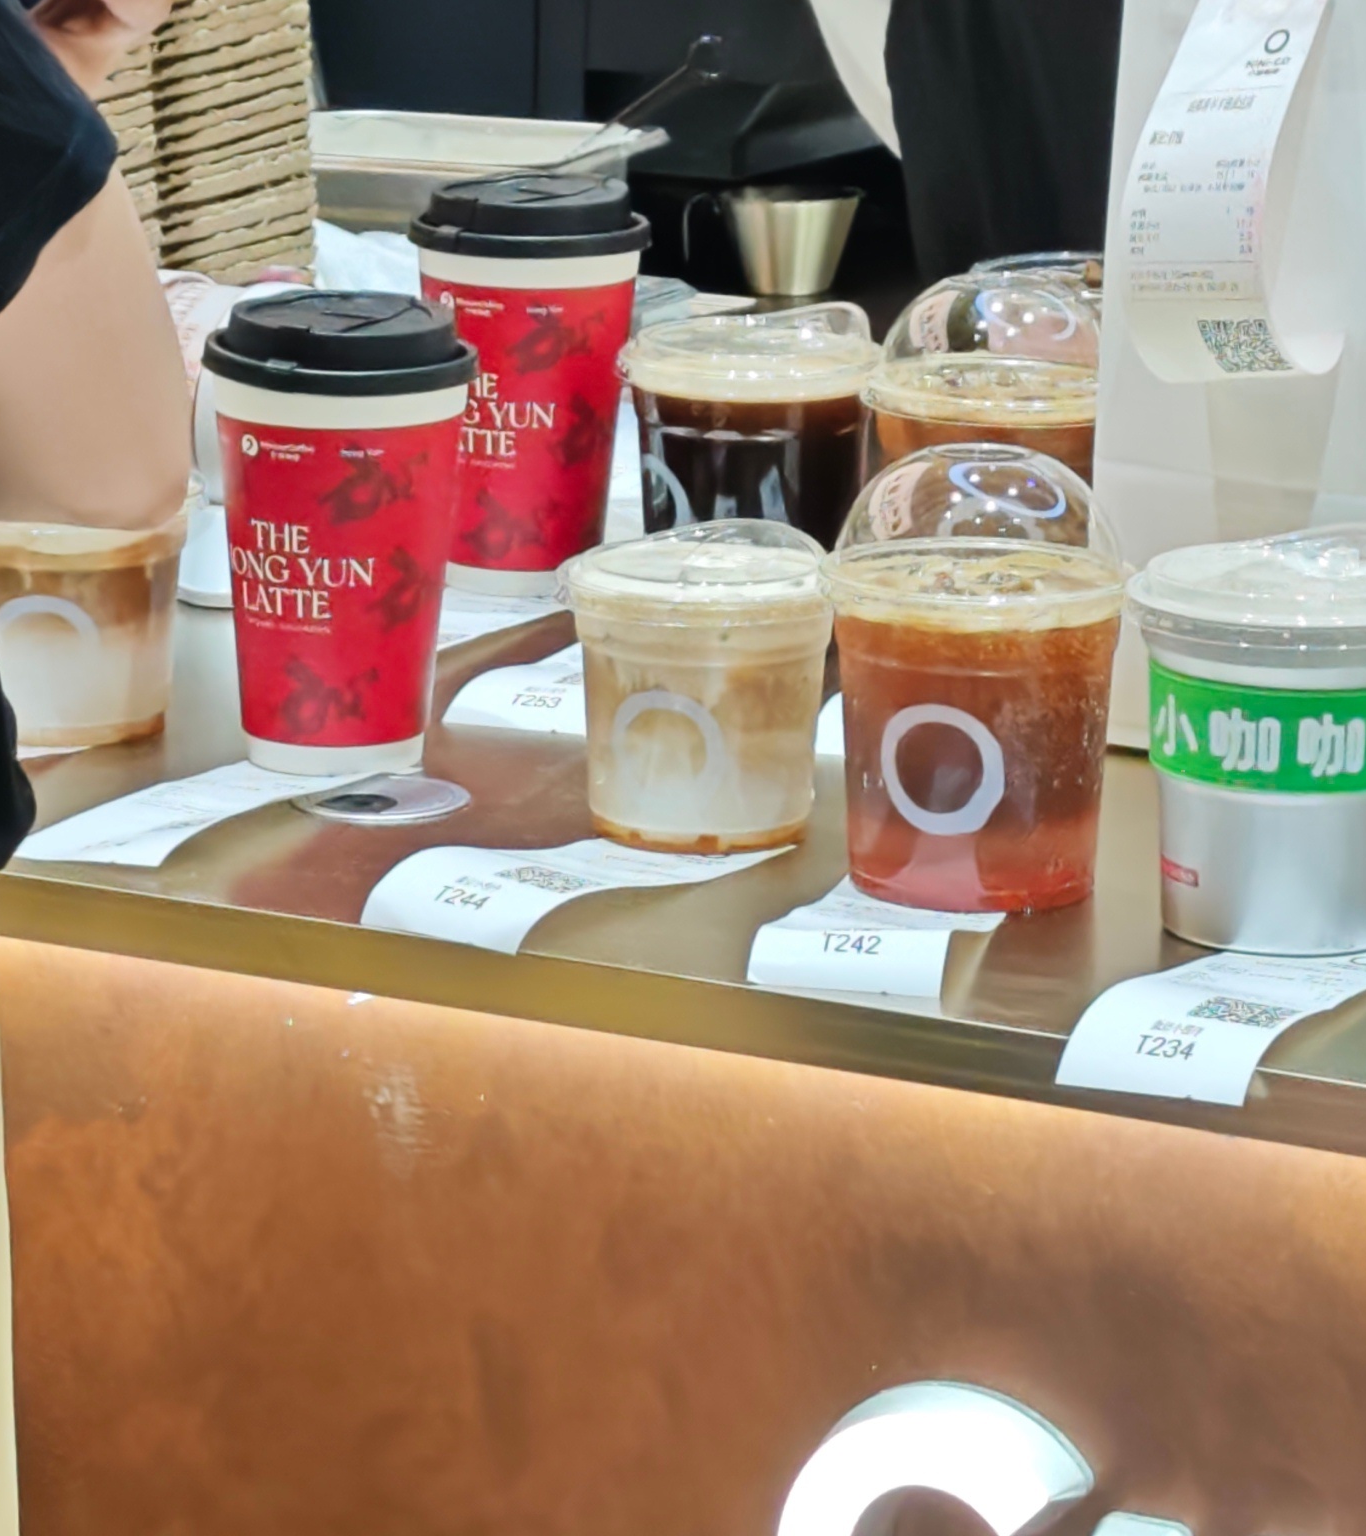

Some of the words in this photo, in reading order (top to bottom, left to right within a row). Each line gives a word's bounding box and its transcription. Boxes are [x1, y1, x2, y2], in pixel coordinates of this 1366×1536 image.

[487, 400, 557, 430] YUN
[459, 426, 517, 457] TTE
[249, 517, 311, 555] THE
[229, 542, 291, 584] ONG
[297, 556, 376, 588] YUN
[241, 579, 333, 620] LATTE
[511, 693, 563, 709] T253
[434, 885, 491, 910] T244
[822, 932, 883, 956] T242
[1135, 1034, 1197, 1061] T234
